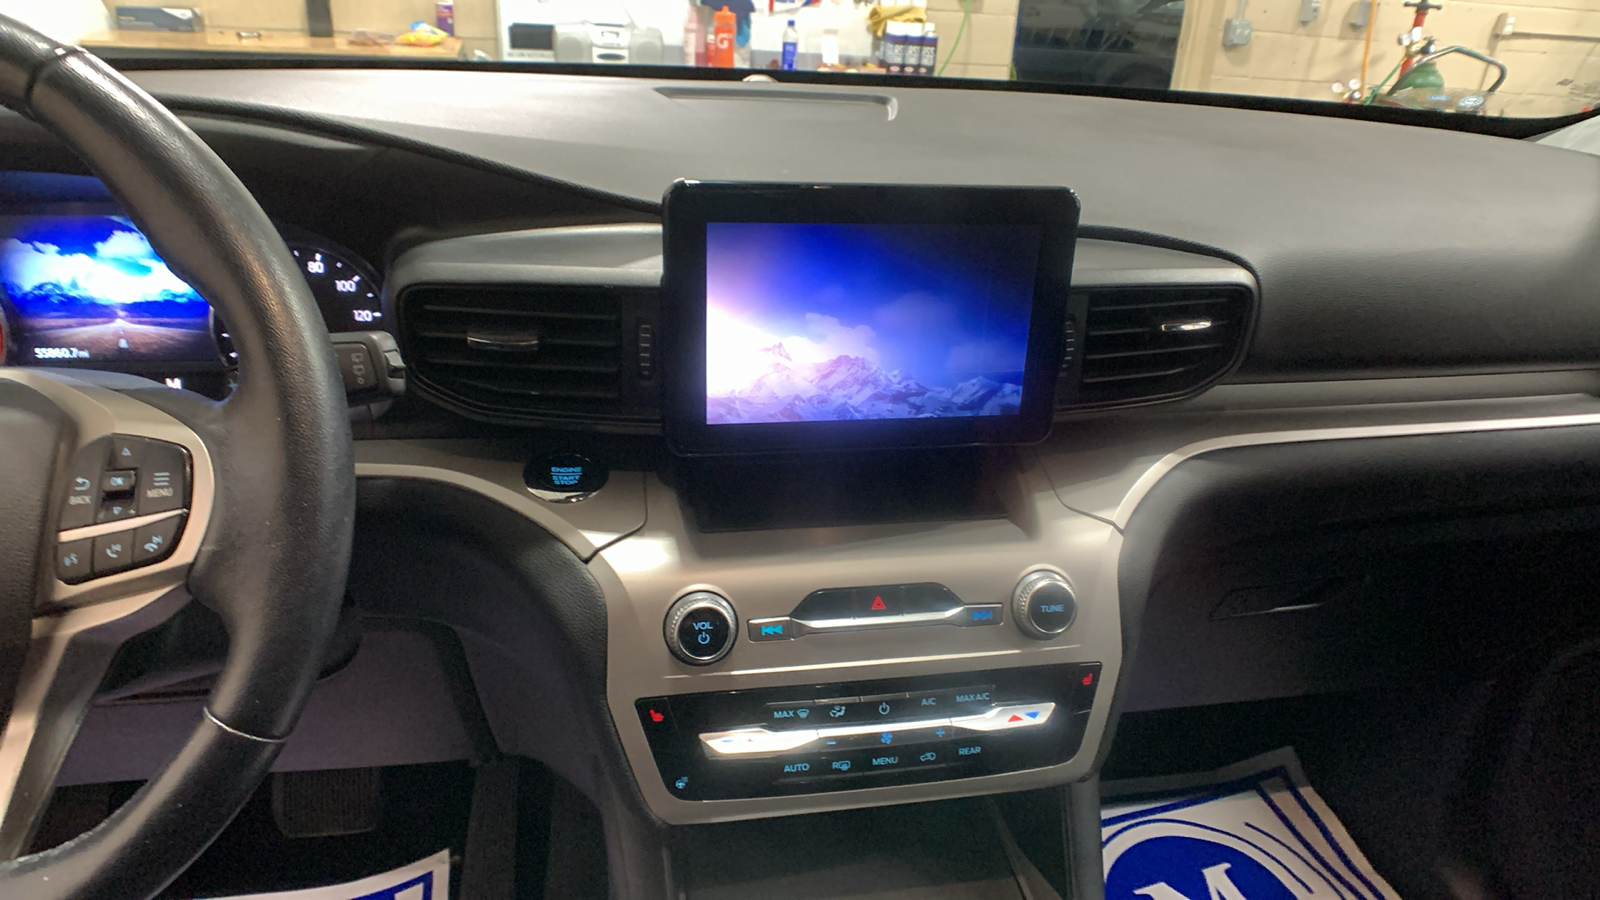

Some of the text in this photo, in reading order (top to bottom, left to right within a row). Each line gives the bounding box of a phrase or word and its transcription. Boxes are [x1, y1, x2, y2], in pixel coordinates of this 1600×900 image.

[307, 261, 325, 274] 80
[335, 280, 357, 292] 100
[353, 310, 373, 322] 120
[109, 476, 124, 487] OK
[146, 487, 173, 498] MENU
[68, 495, 92, 506] BACK
[1040, 604, 1064, 613] TUNE
[692, 621, 714, 630] VOL
[921, 697, 936, 706] A/C
[955, 692, 990, 702] MAX A/C
[773, 709, 795, 719] MAX
[958, 746, 982, 756] REAR
[872, 756, 899, 766] MENU
[783, 763, 810, 773] AUTO
